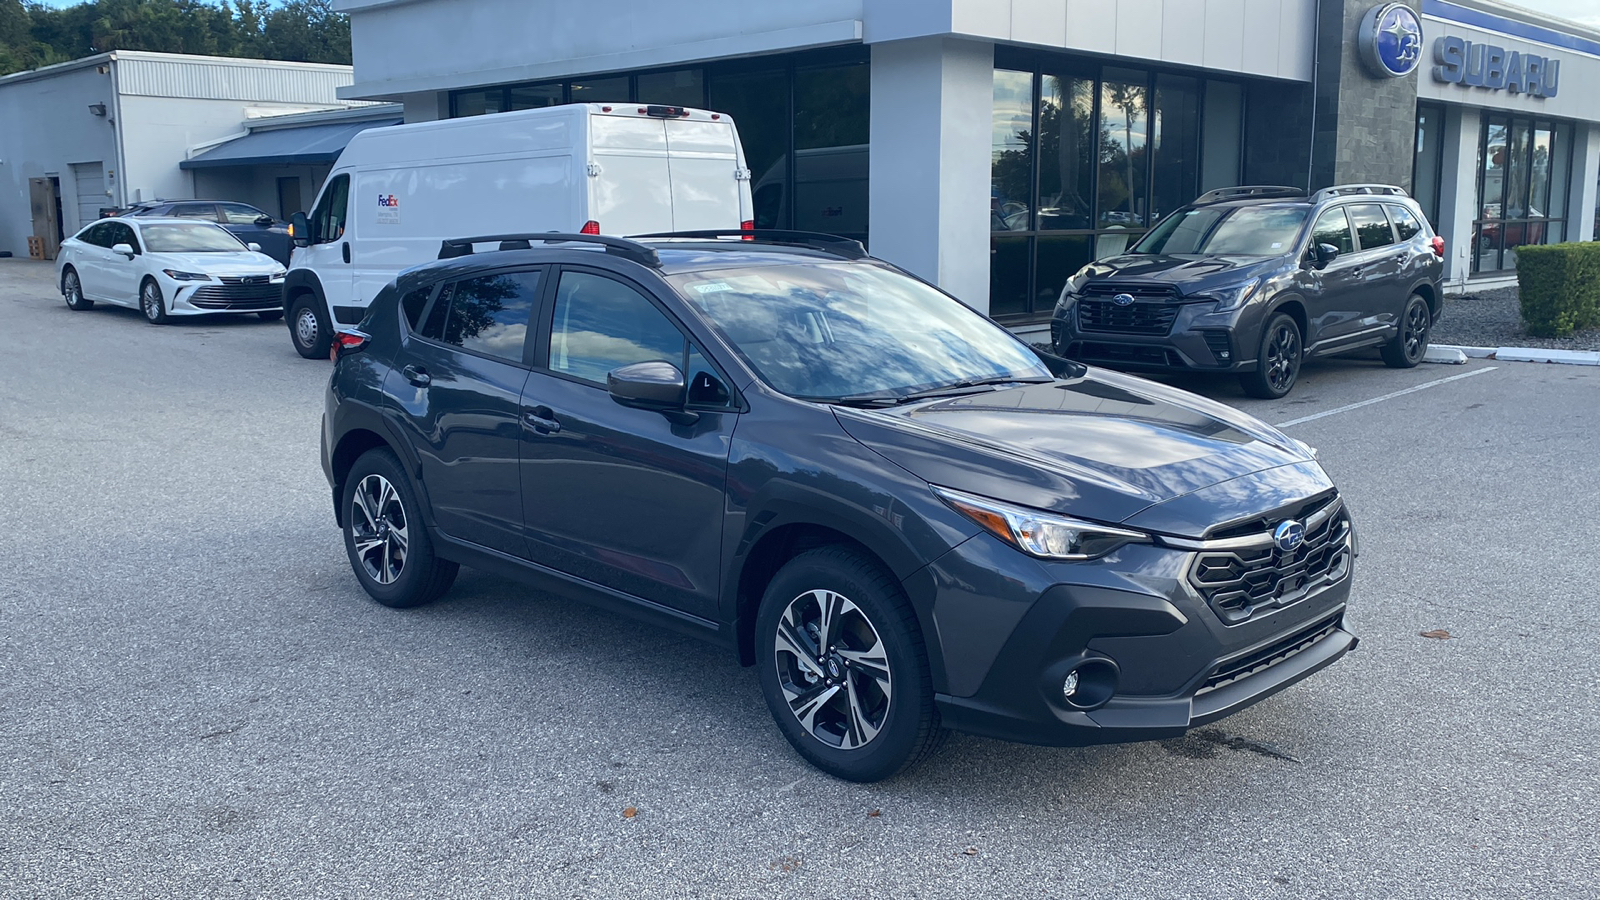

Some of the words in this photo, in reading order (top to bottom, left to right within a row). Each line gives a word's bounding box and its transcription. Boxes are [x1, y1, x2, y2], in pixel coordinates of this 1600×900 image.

[1433, 36, 1560, 99] SUBARU
[378, 194, 398, 207] FedEx
[844, 578, 891, 636] YOKOHAMA
